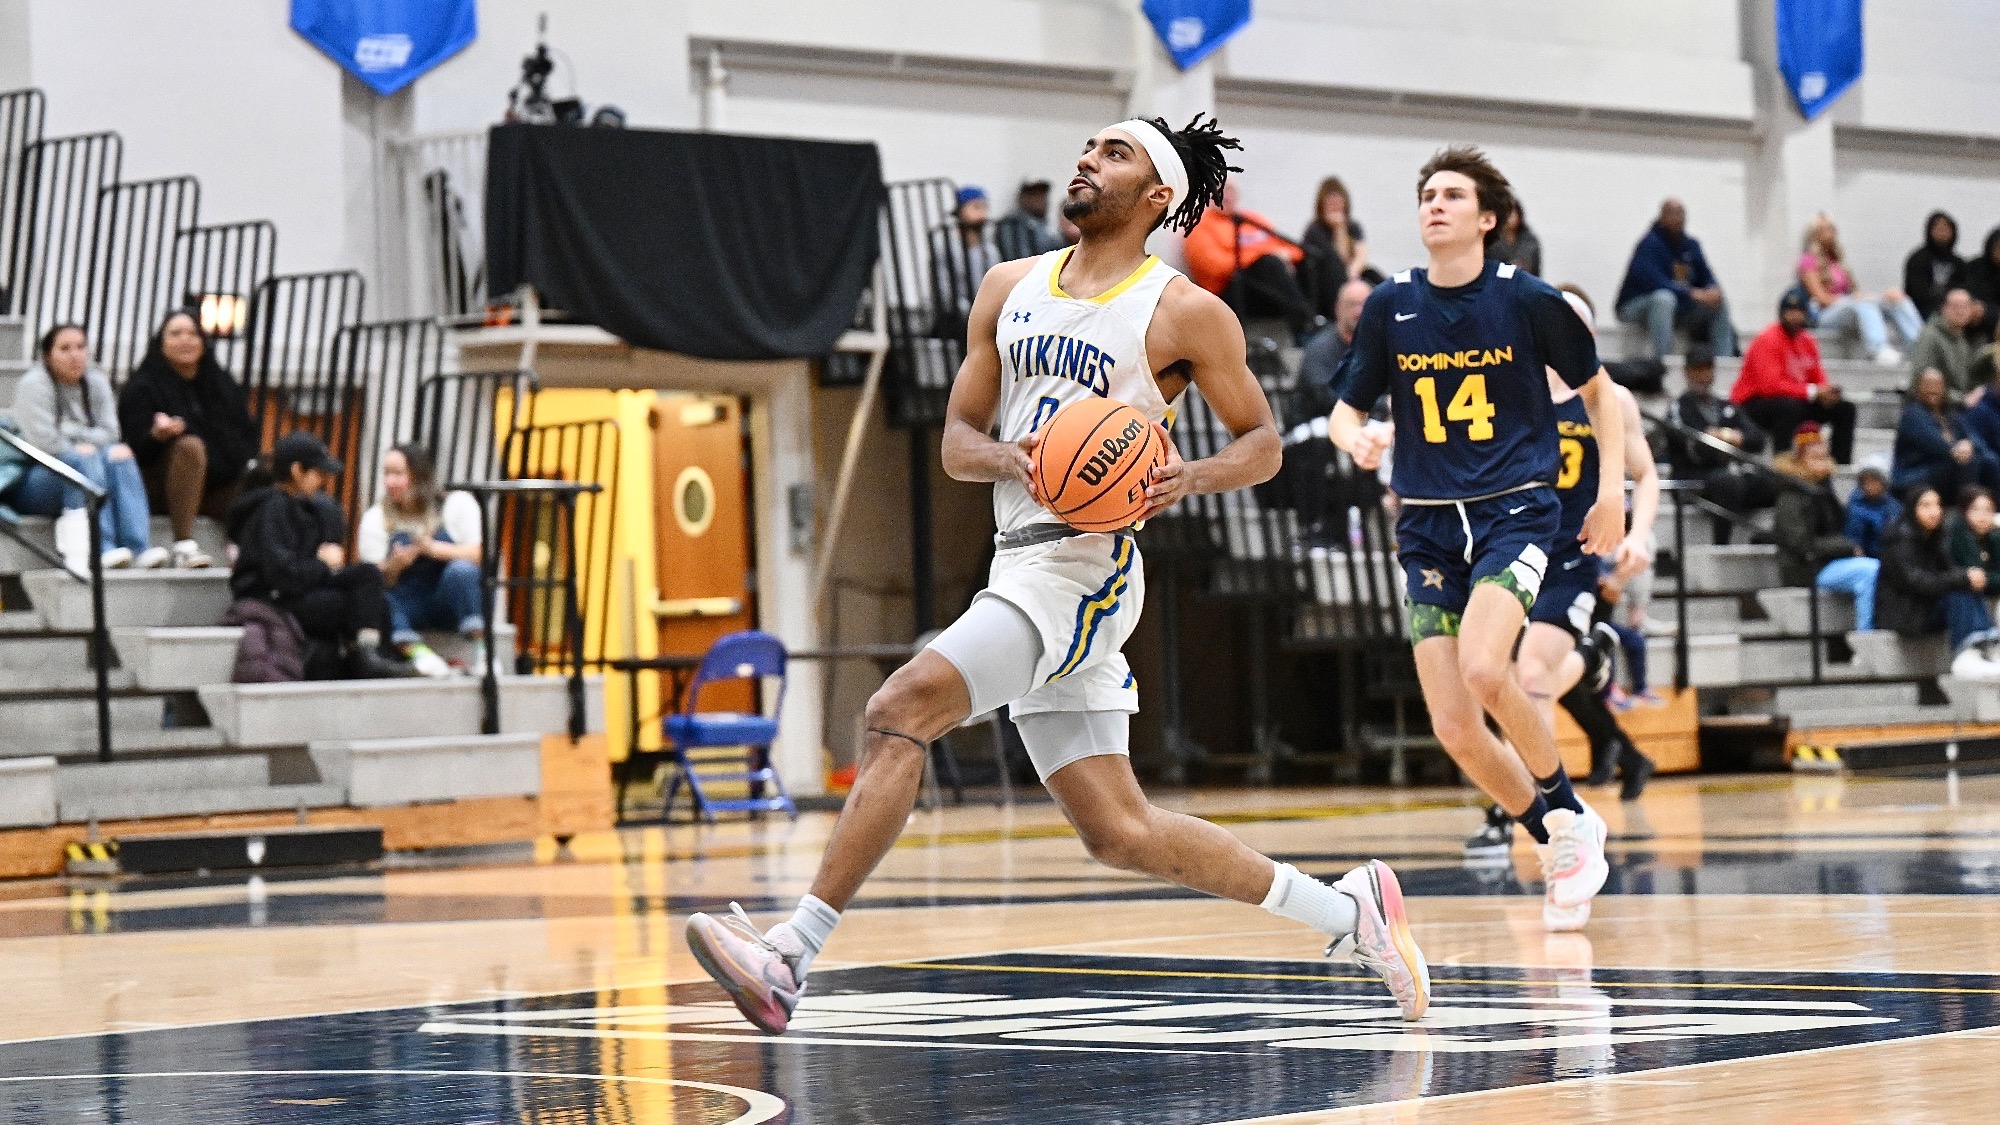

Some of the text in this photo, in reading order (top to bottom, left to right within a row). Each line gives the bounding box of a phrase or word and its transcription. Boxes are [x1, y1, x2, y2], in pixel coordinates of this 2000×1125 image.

[1009, 335, 1116, 398] VIKINGS
[1397, 346, 1513, 371] DOMINICAN
[1414, 374, 1496, 443] 14
[1076, 418, 1145, 487] Wilson
